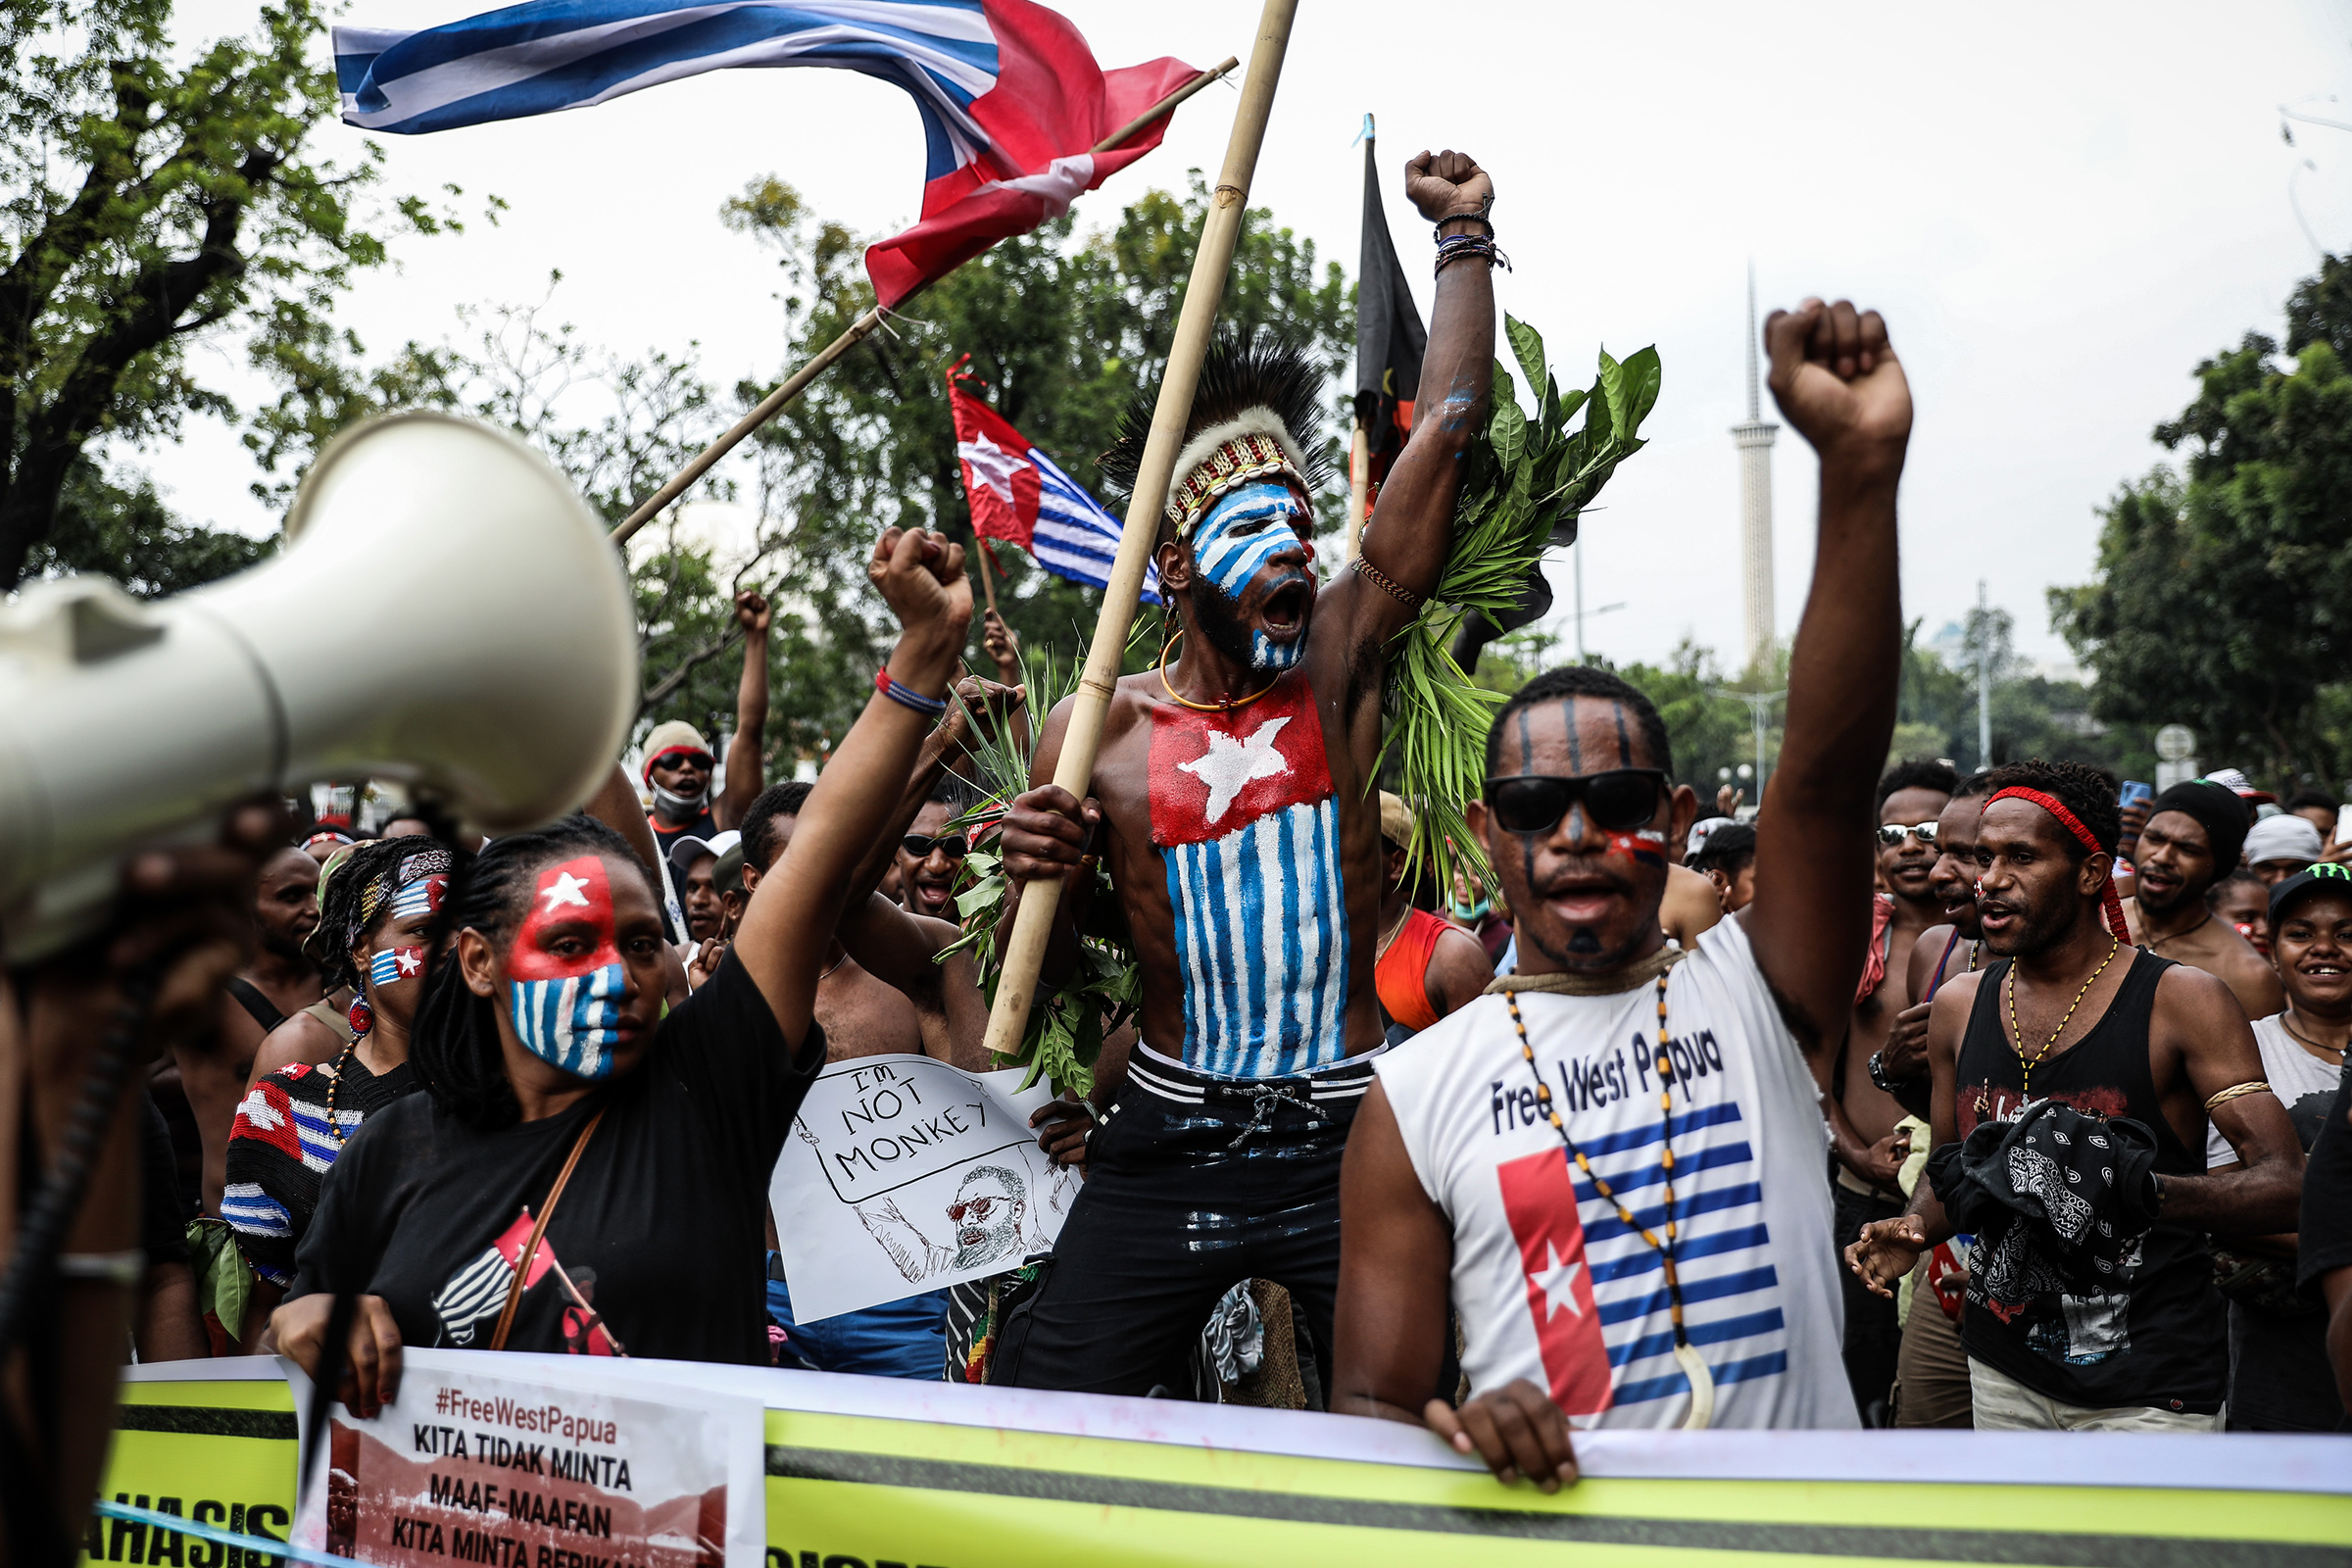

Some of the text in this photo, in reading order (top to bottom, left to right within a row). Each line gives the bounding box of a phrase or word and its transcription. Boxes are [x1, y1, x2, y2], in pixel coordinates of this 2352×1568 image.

[842, 1077, 921, 1135] NOT
[1491, 1027, 1724, 1135] Free West Papua
[835, 1102, 986, 1181] MONKEY
[435, 1388, 616, 1446] #FreeWestPapua
[414, 1424, 632, 1491] KITA TIDAK MINTA
[430, 1473, 611, 1539] MAAF-MAAFAN
[392, 1516, 445, 1555] KITA
[452, 1527, 532, 1568] MINTA
